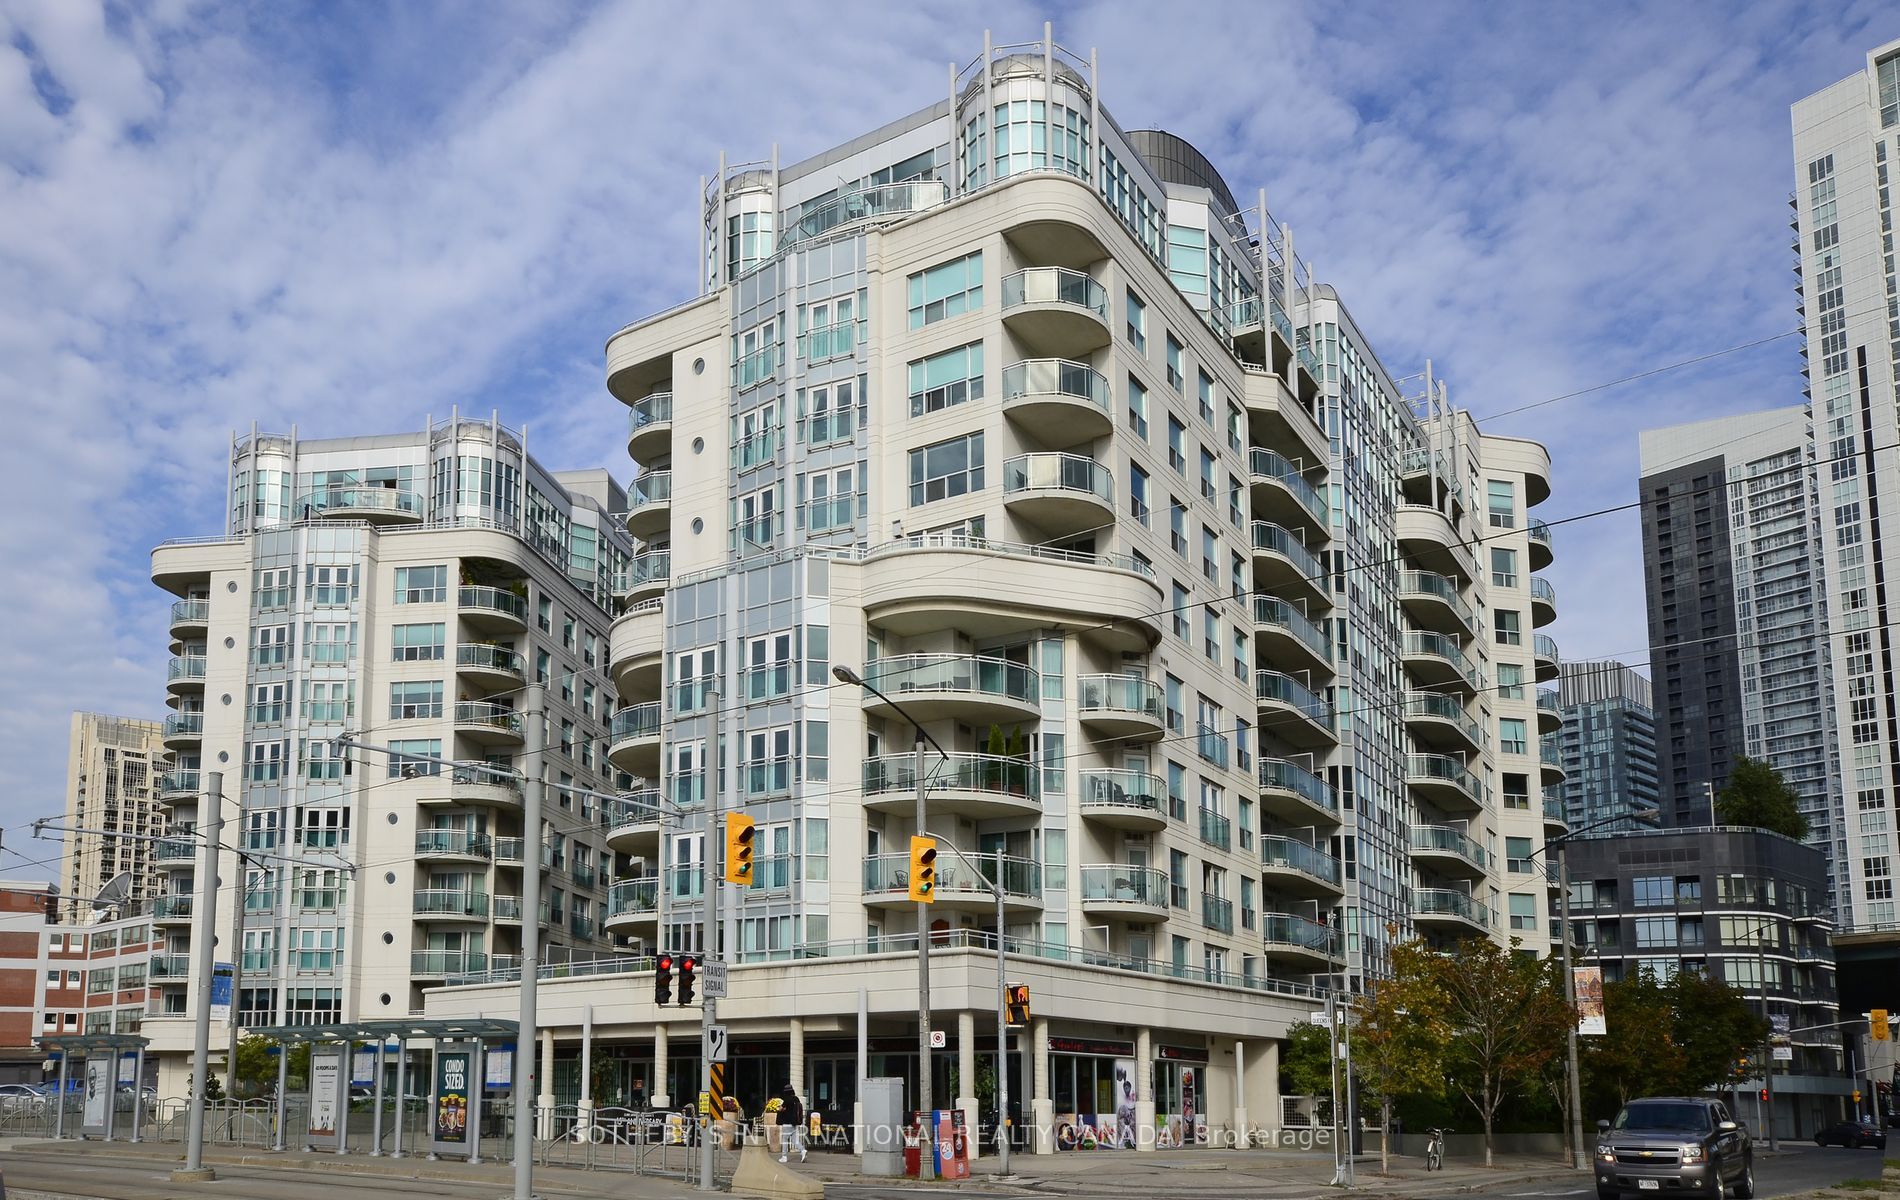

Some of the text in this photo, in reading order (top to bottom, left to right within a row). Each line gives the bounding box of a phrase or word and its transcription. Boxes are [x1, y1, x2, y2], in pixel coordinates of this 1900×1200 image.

[704, 965, 726, 978] TRANSIT
[705, 979, 724, 992] SIGNAL
[445, 1059, 465, 1073] CONDO
